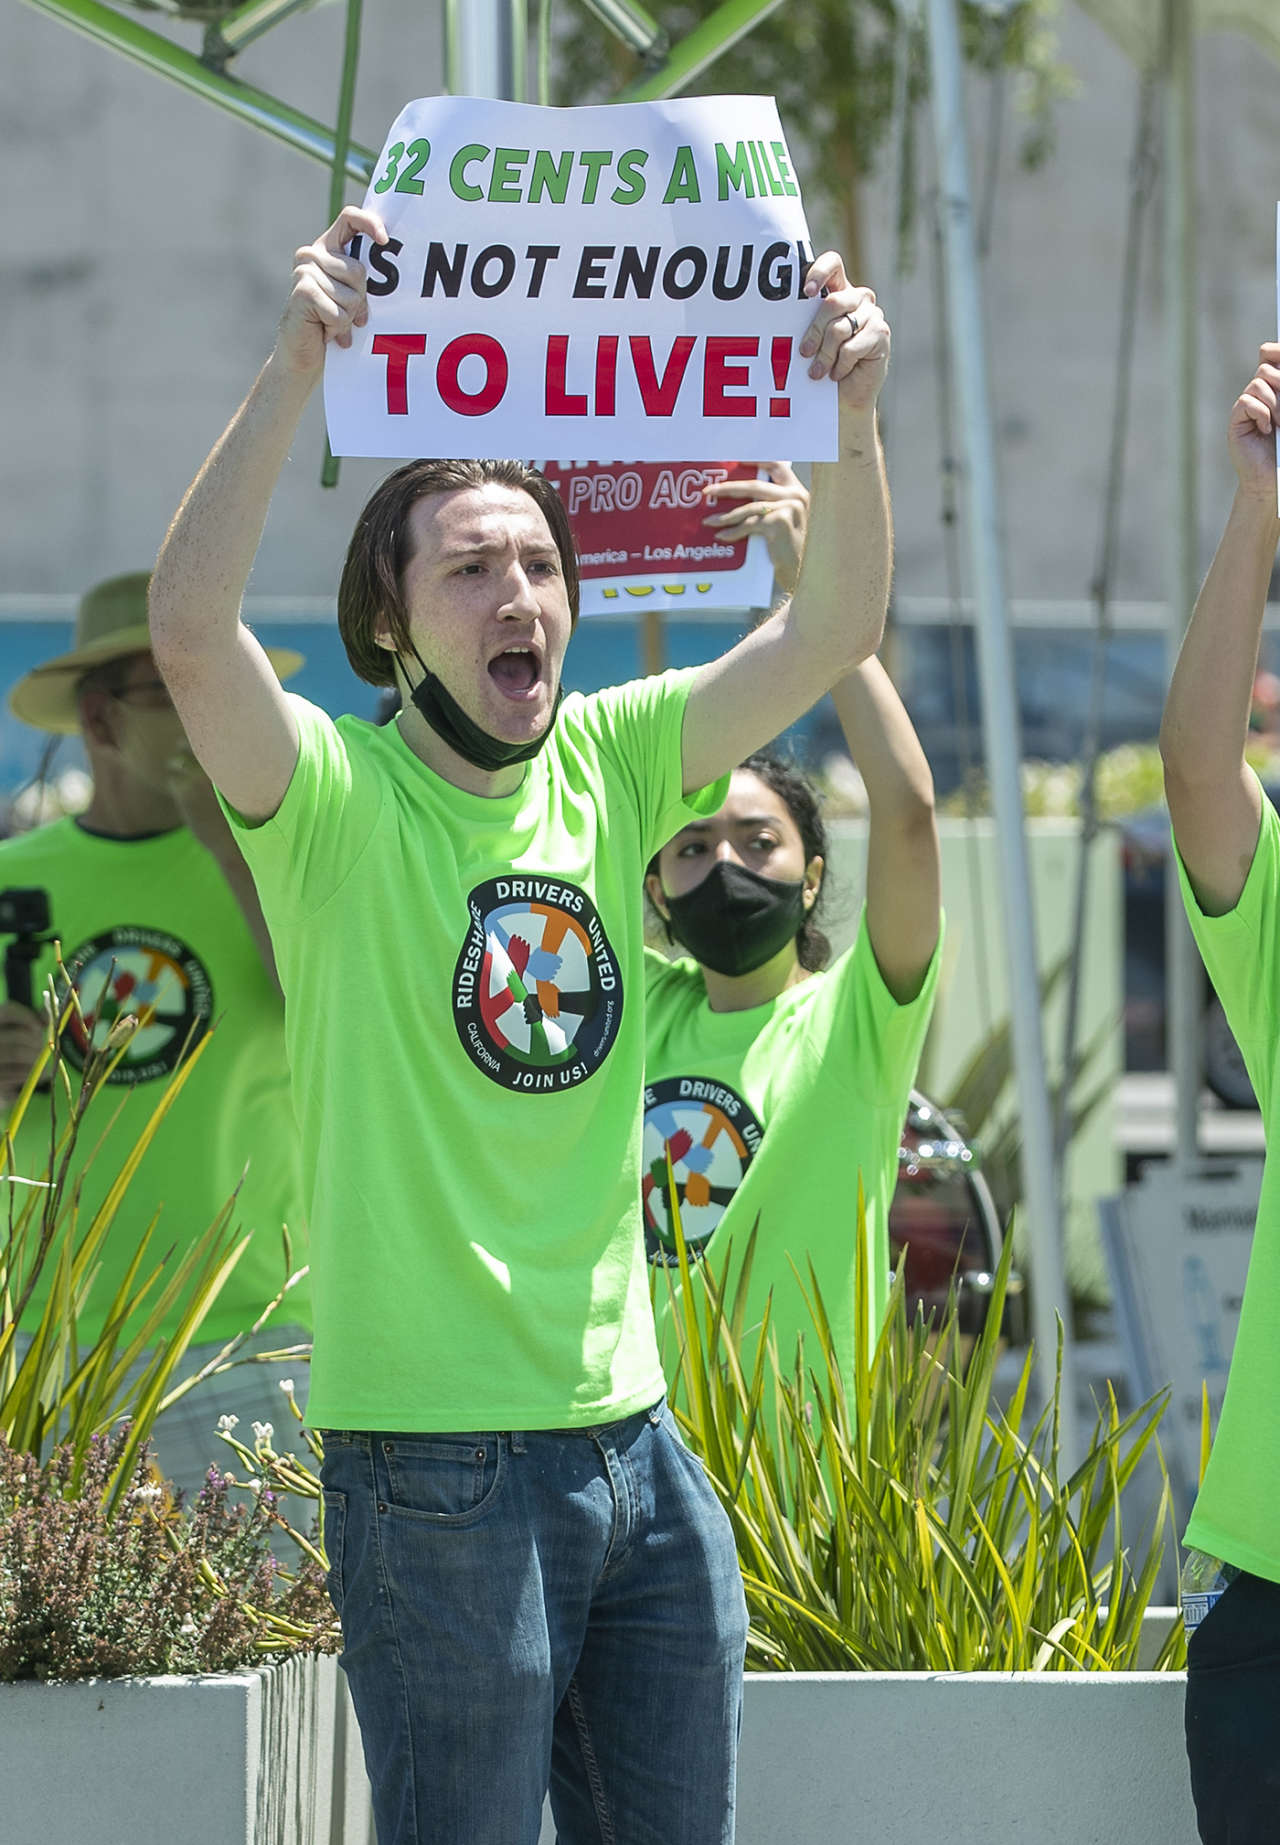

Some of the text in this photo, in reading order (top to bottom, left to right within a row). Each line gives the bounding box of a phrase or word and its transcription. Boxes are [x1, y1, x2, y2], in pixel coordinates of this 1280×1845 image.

[374, 137, 799, 205] 32 CENTS A MILE
[420, 241, 561, 299] NOT
[371, 333, 793, 419] TO LIVE!
[568, 469, 728, 515] PRO ACT
[575, 547, 628, 566] merica
[644, 545, 672, 561] Los
[674, 542, 735, 562] Angeles
[495, 880, 585, 913] DRIVERS
[588, 916, 616, 991] UNITED
[467, 1022, 501, 1073] CALIFORNIA
[512, 1062, 588, 1089] JOIN US!
[679, 1079, 742, 1118] DRIVERS
